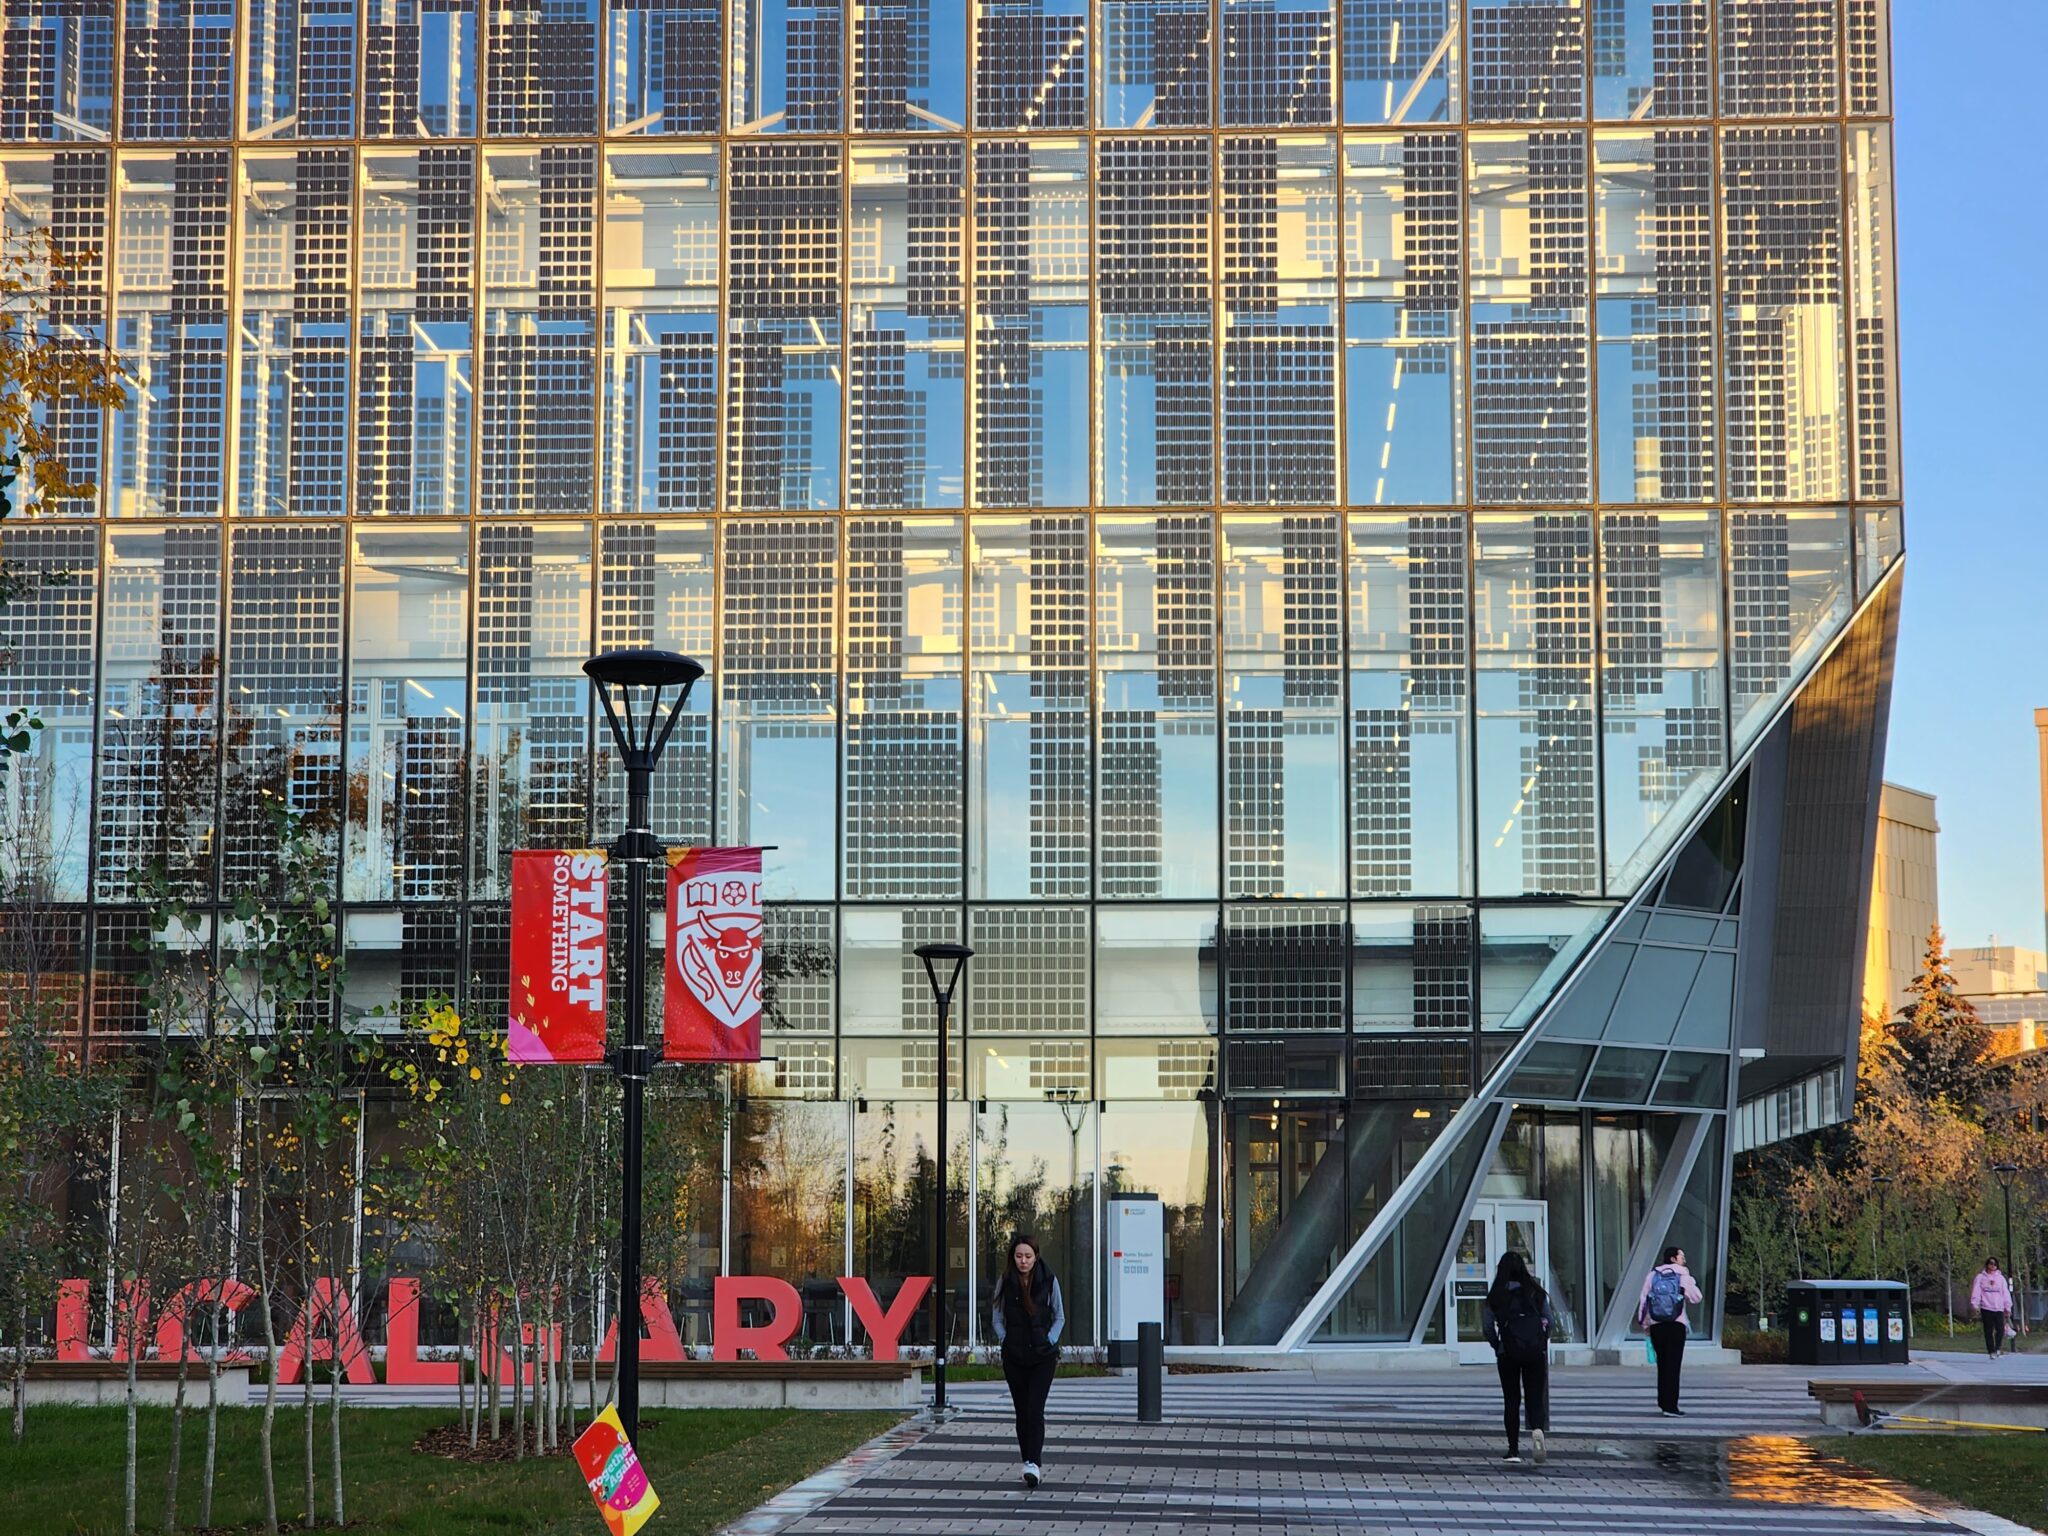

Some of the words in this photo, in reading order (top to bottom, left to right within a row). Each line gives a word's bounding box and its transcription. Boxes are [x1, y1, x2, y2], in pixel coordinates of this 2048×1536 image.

[552, 855, 569, 991] SOMETHING
[570, 855, 604, 1011] START
[589, 1443, 632, 1491] Together
[610, 1454, 638, 1487] Again
